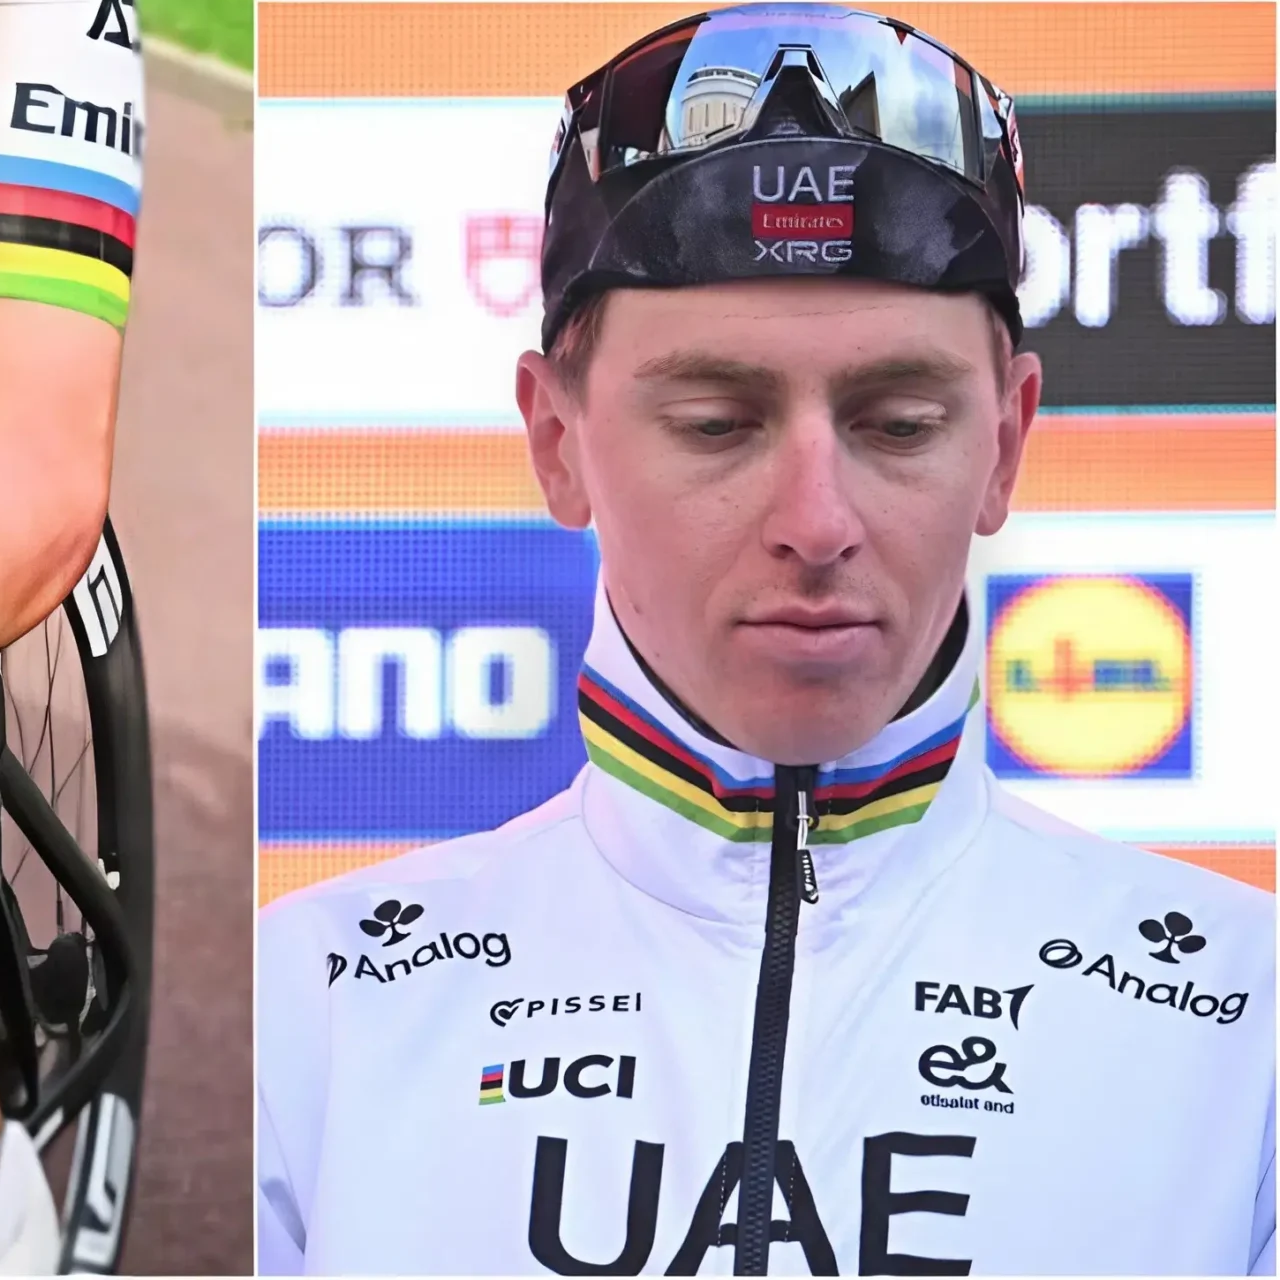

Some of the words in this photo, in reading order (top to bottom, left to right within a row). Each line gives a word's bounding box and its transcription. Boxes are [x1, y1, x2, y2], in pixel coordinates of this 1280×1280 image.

[753, 165, 856, 202] UAE
[753, 240, 853, 262] XRG
[354, 932, 512, 983] Analog
[526, 992, 642, 1018] PISSEI
[1081, 953, 1250, 1024] Analog
[508, 1054, 637, 1100] UCI
[528, 1131, 978, 1276] UAE
